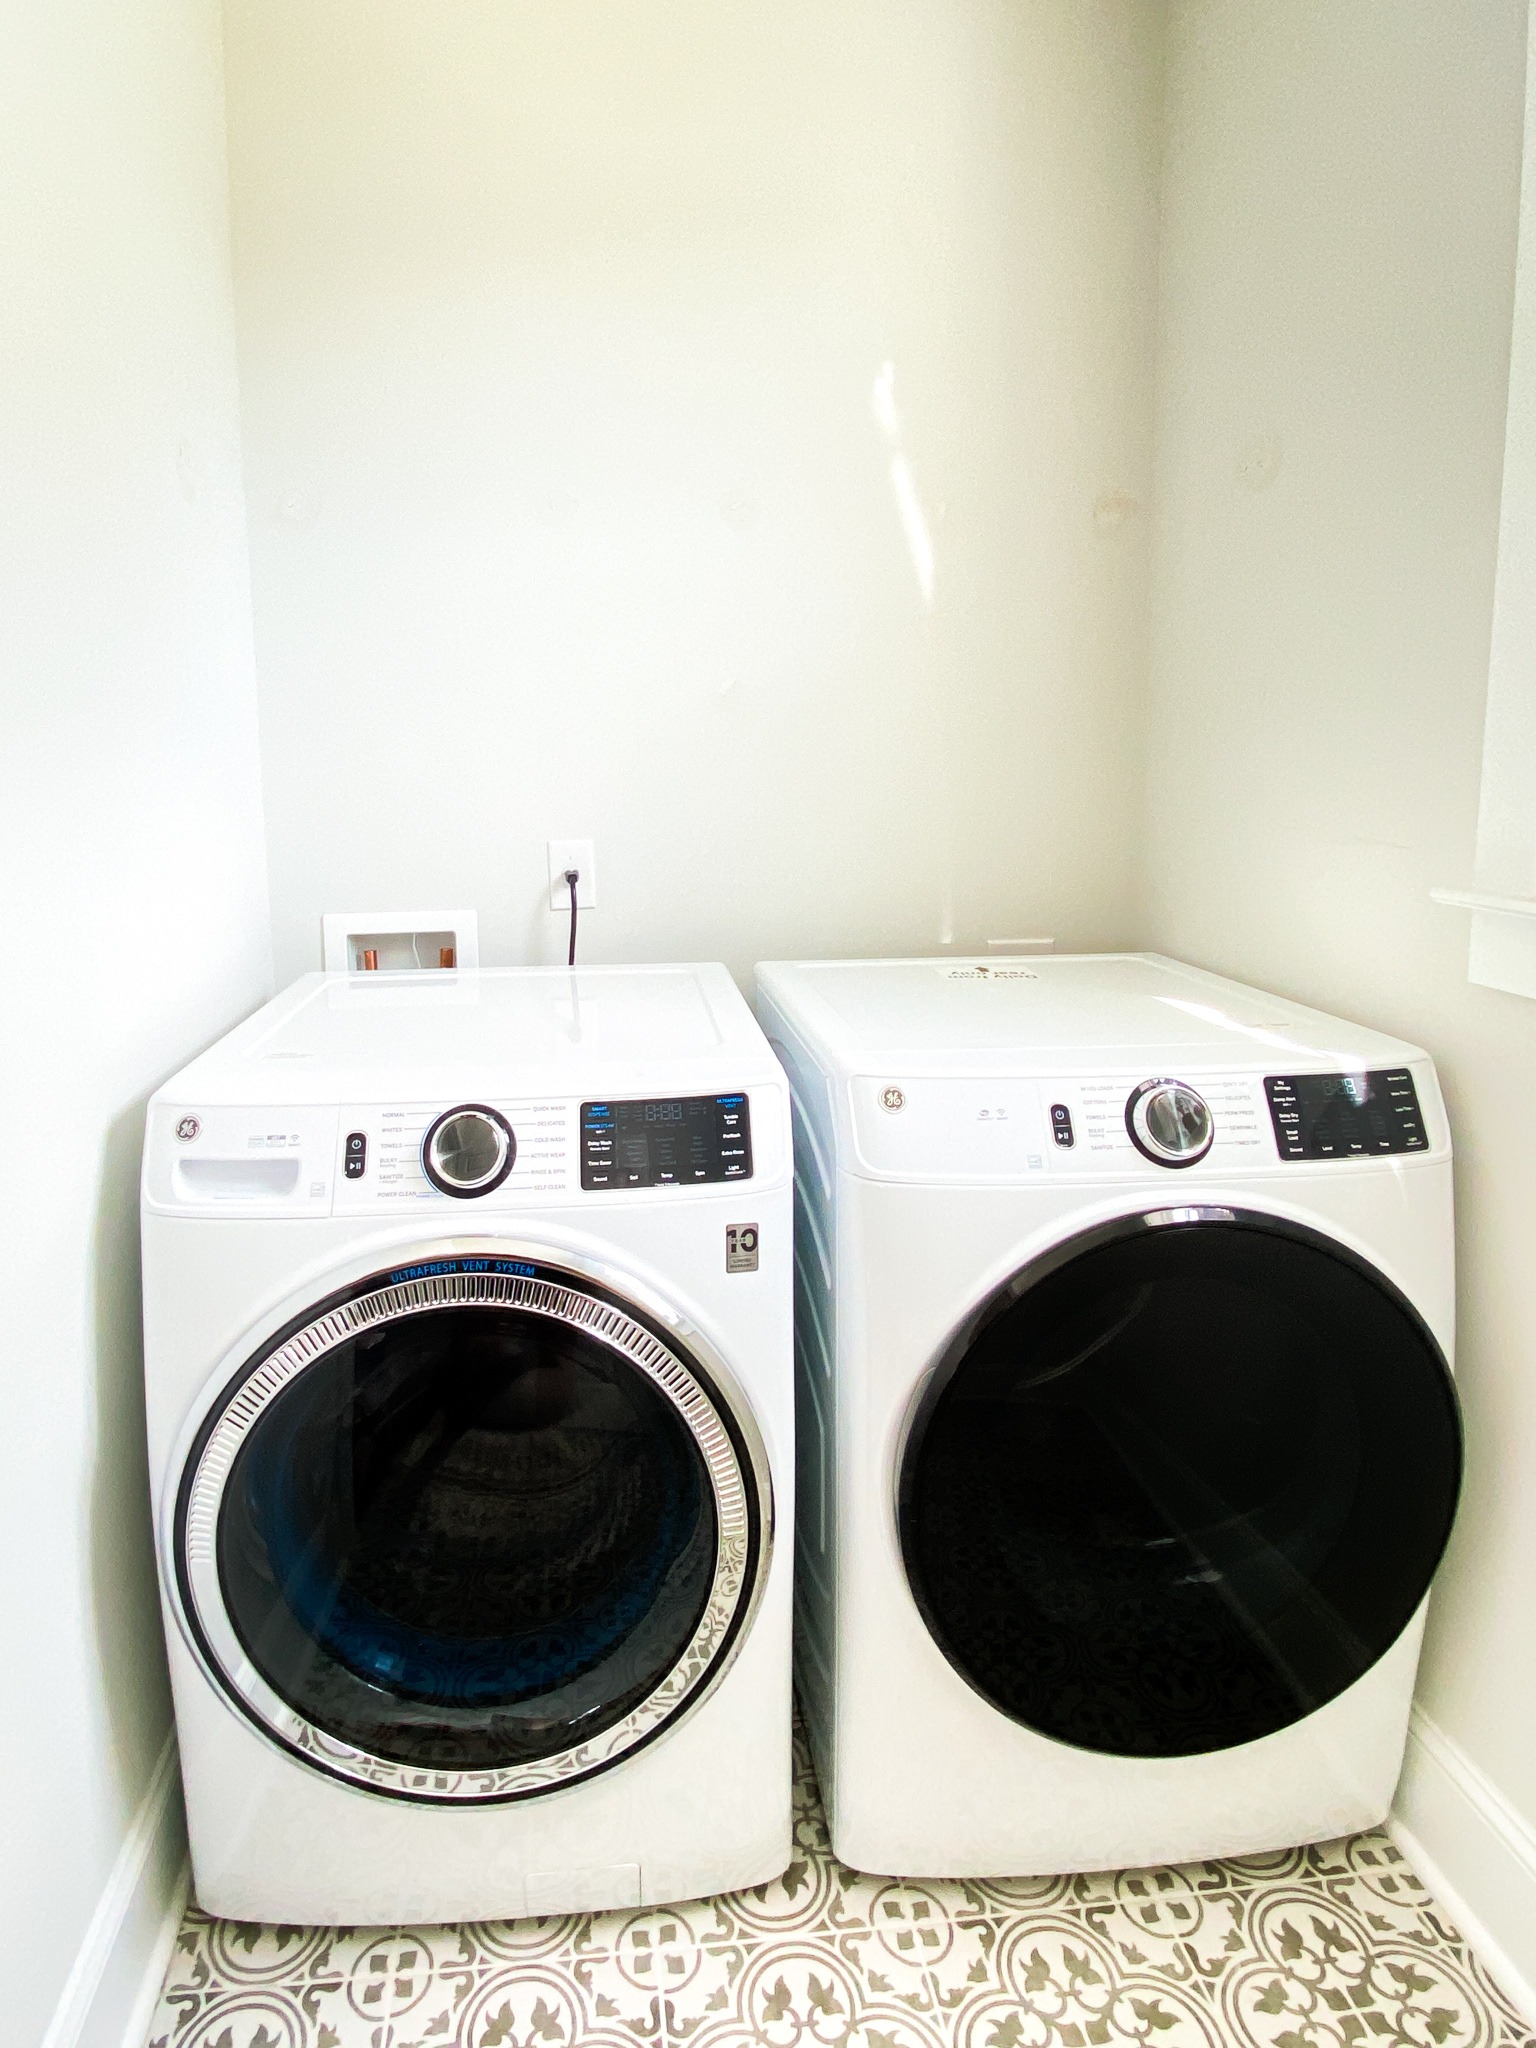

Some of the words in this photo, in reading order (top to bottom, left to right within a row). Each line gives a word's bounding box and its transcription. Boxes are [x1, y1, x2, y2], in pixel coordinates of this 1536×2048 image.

[727, 1228, 758, 1253] 10
[391, 1261, 457, 1283] ULTRAFRESH
[462, 1260, 490, 1272] VENT
[495, 1261, 536, 1277] SYSTEM
